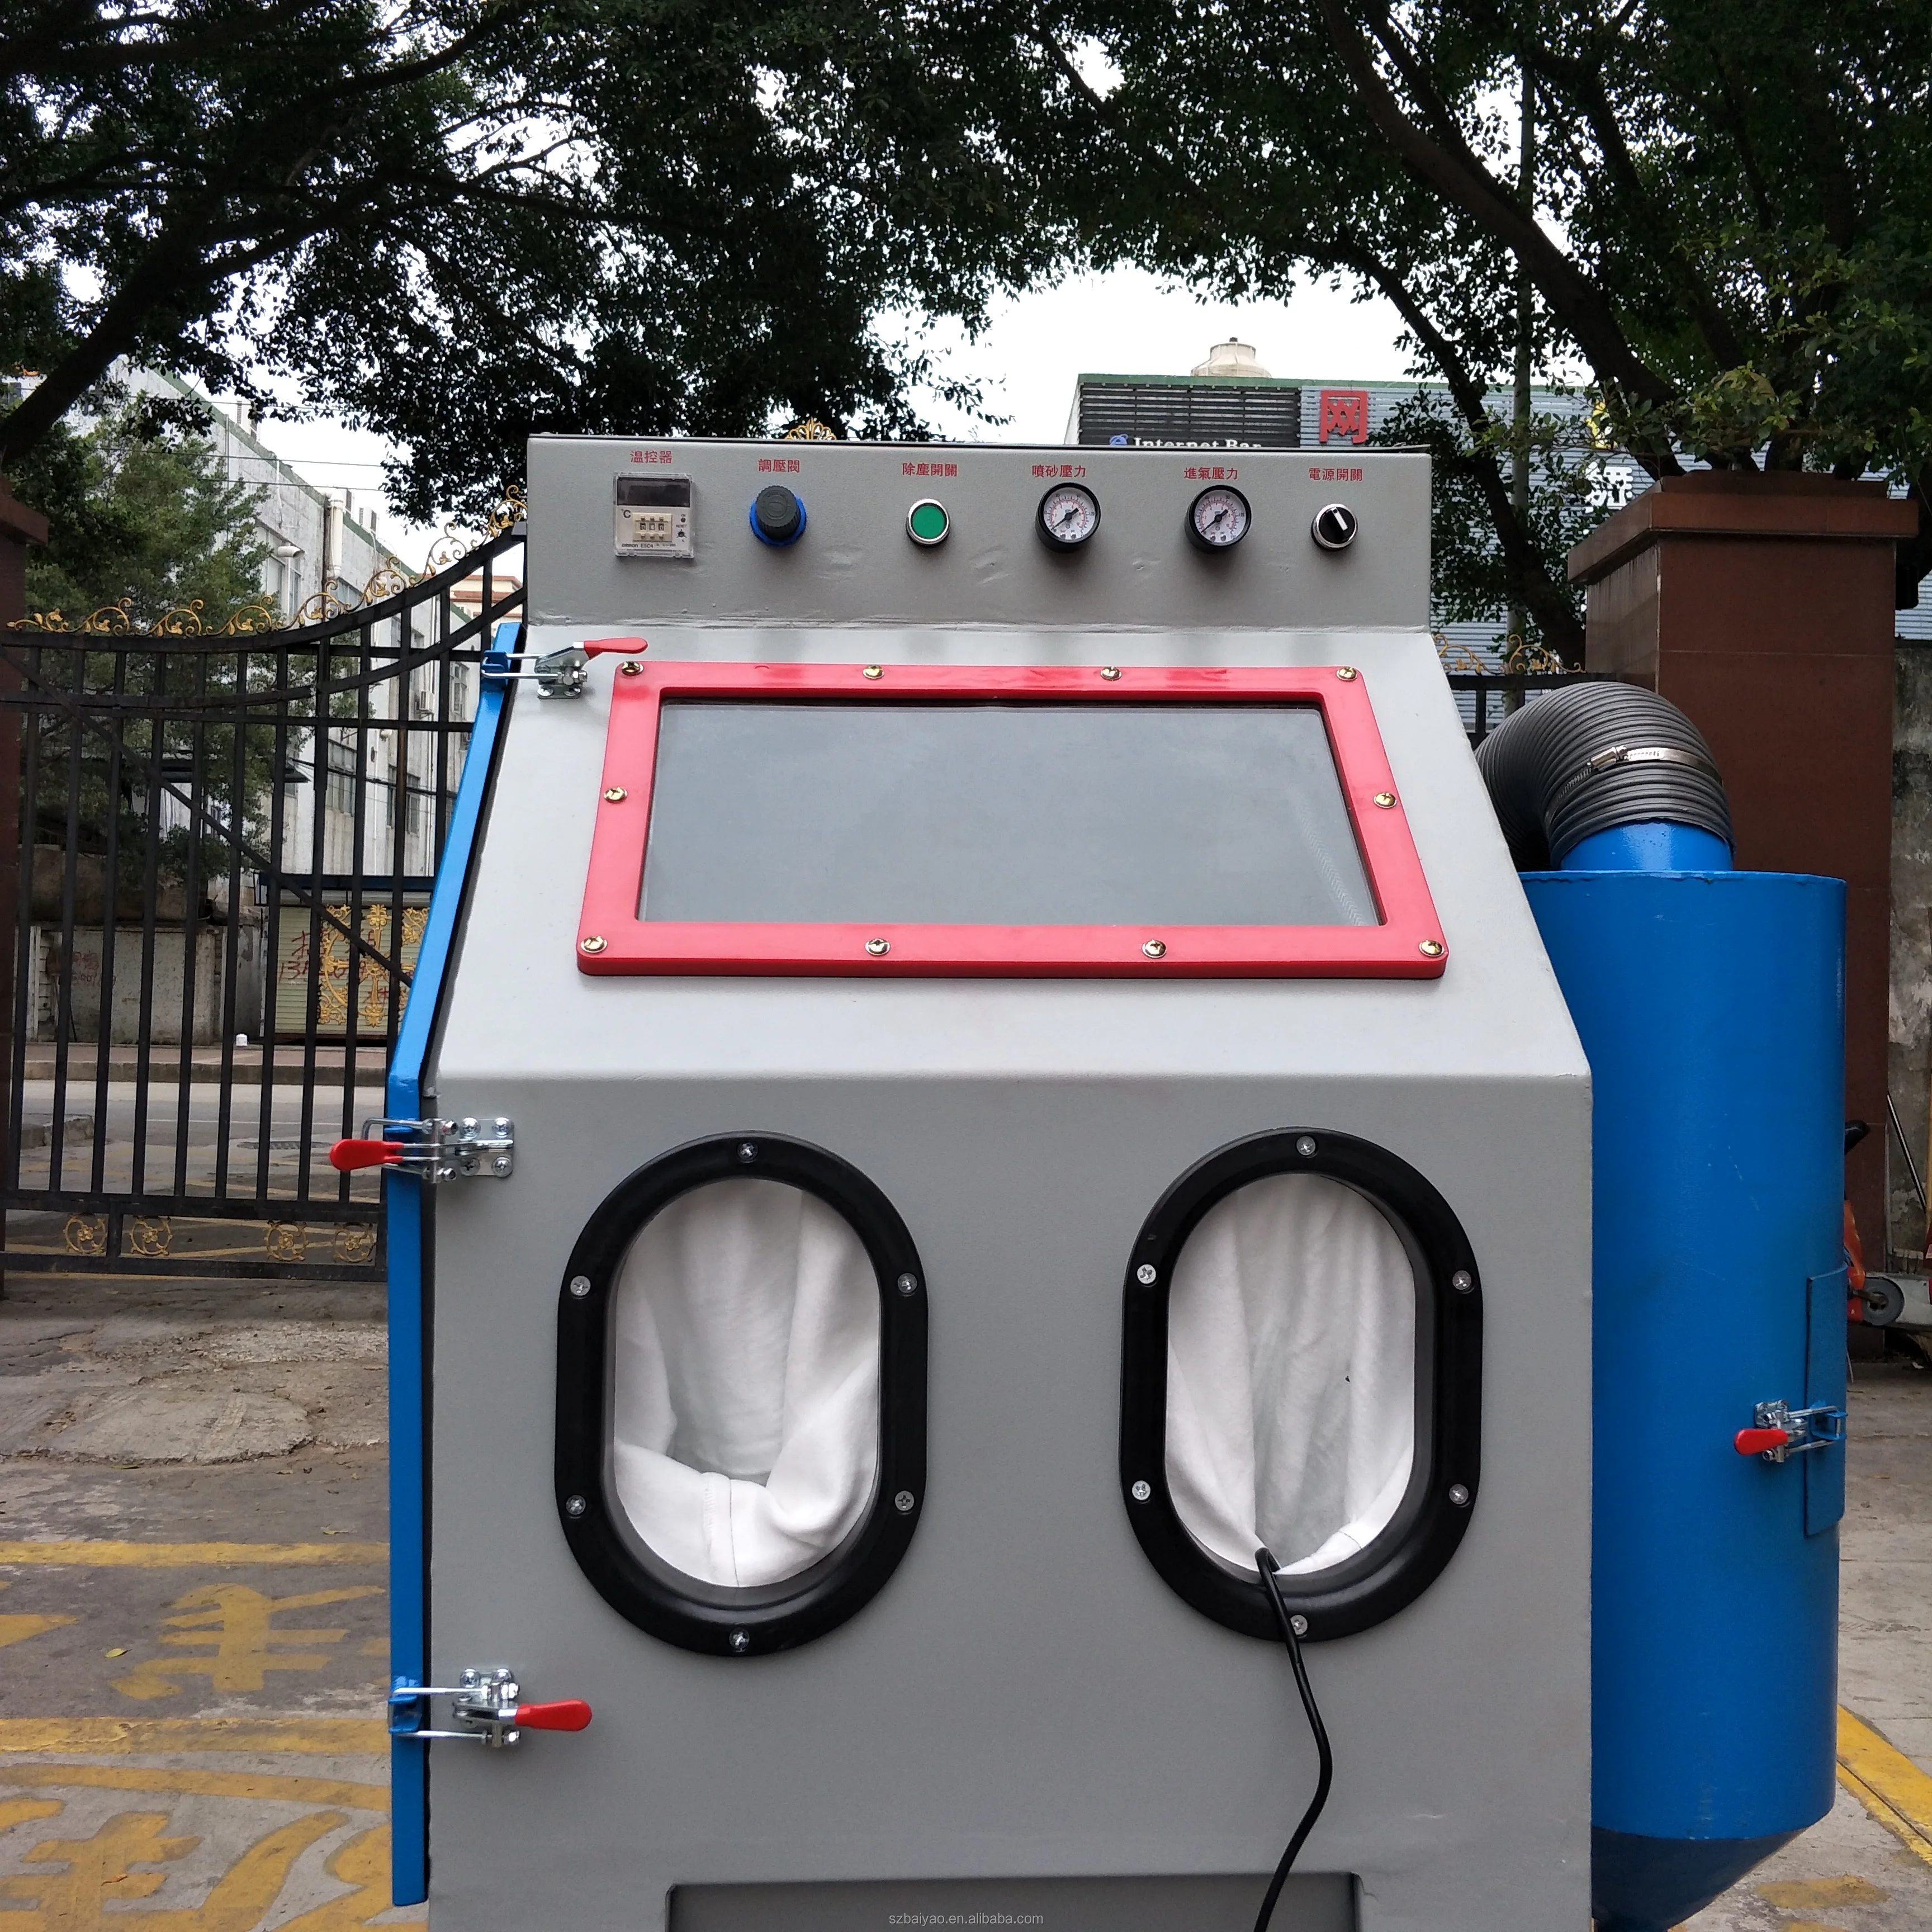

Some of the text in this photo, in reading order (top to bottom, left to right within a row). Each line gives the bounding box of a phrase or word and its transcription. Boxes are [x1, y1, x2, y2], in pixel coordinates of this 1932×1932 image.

[1319, 389, 1368, 444] 网
[1133, 437, 1219, 447] Internet
[629, 450, 673, 464] 温控器
[758, 459, 800, 473] 調壓閥
[902, 462, 958, 477] 除塵開關
[1032, 465, 1086, 477] 噴砂壓力
[1183, 467, 1238, 480] 進氣壓力
[1309, 467, 1363, 481] 電源開關
